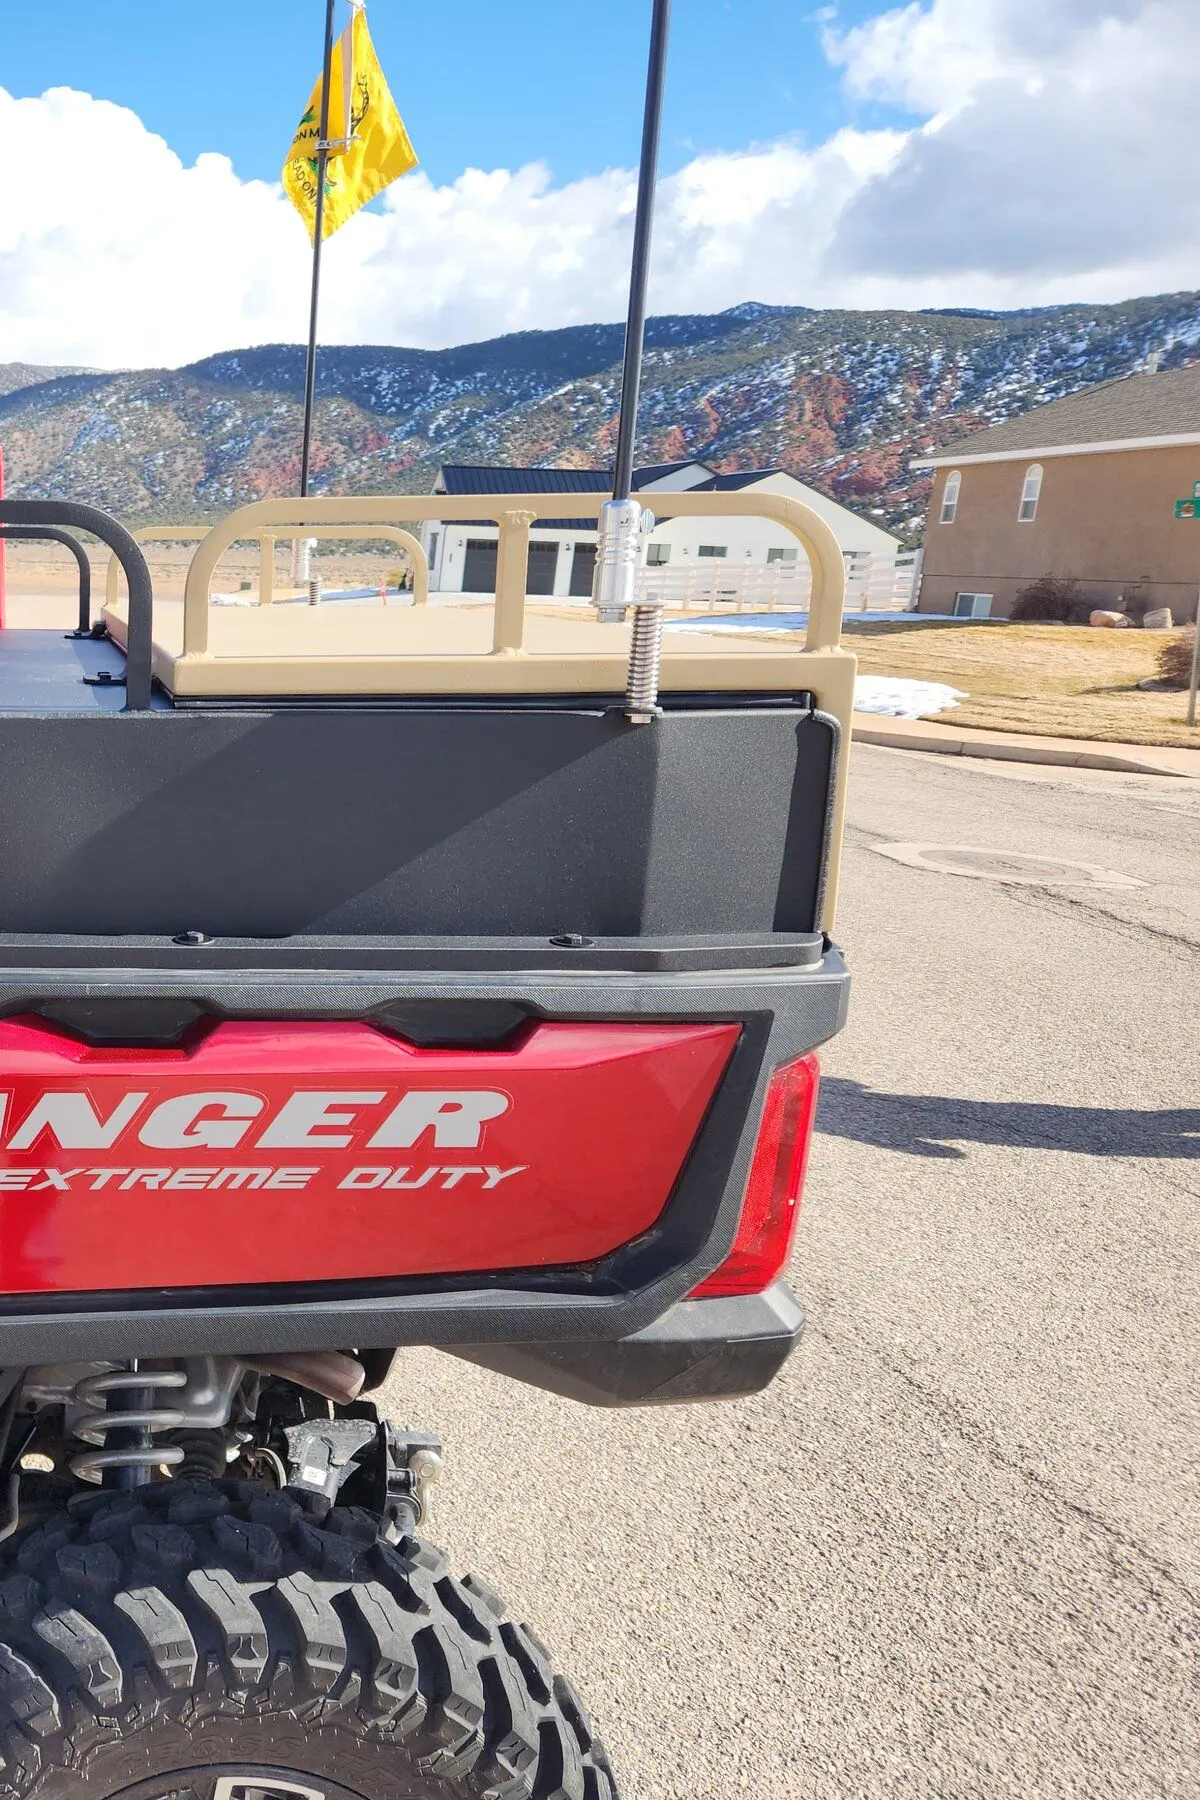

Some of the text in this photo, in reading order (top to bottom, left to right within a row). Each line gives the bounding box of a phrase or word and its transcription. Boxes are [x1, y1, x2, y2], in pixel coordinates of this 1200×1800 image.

[309, 127, 320, 138] M
[292, 158, 306, 181] EAD
[335, 1165, 530, 1190] DUTY
